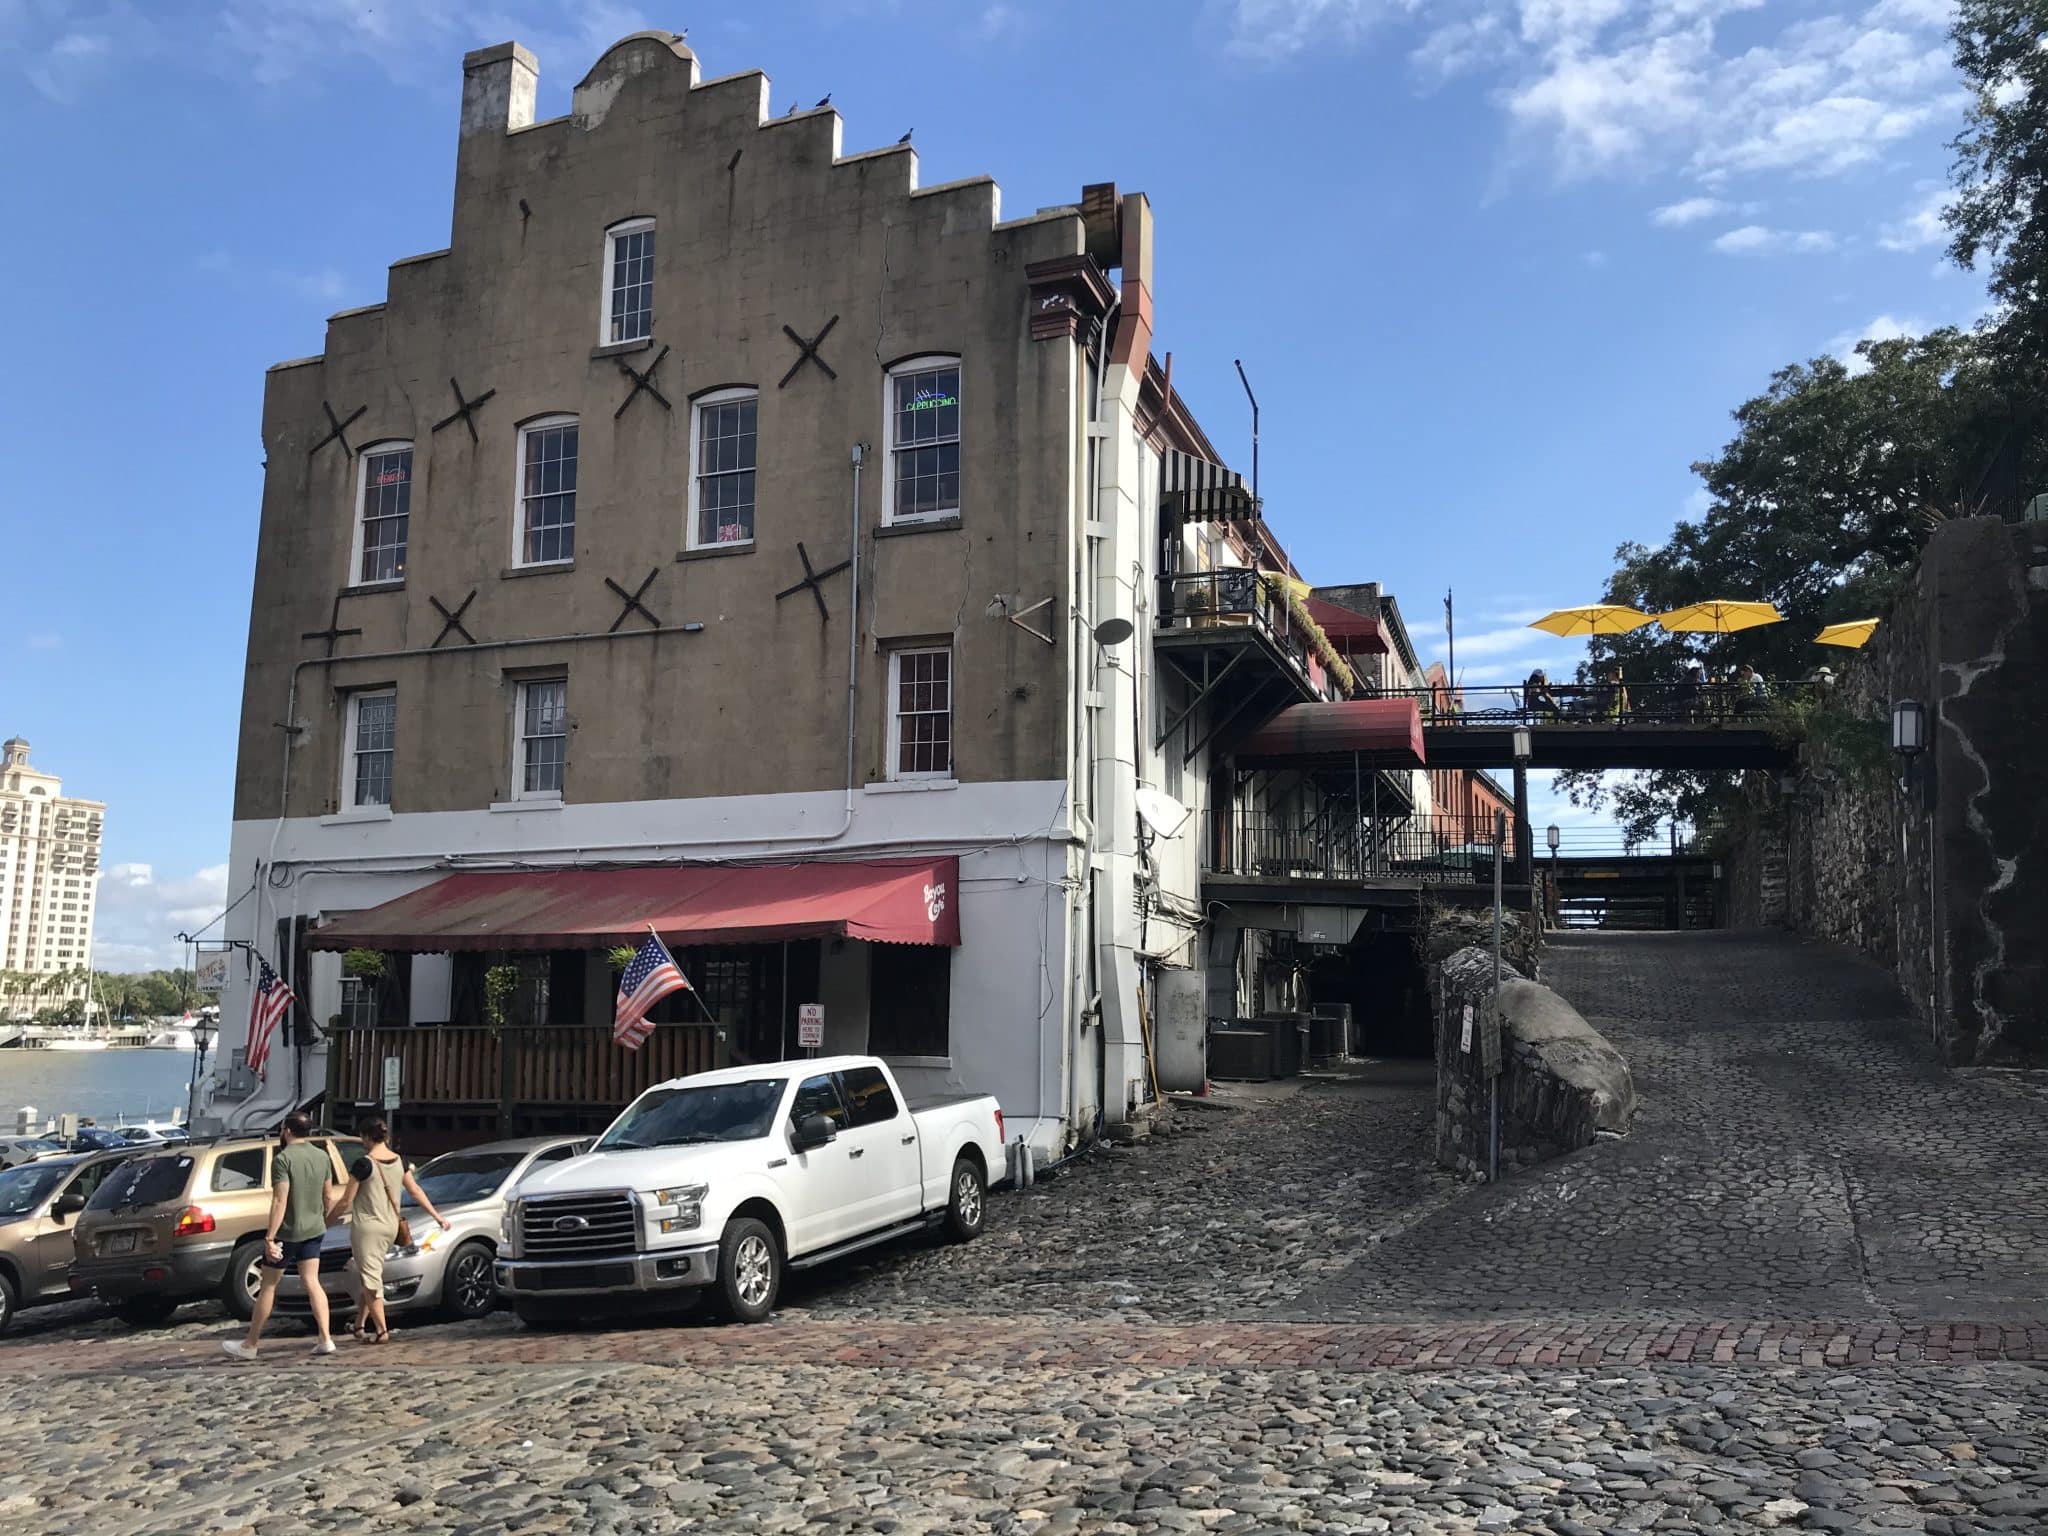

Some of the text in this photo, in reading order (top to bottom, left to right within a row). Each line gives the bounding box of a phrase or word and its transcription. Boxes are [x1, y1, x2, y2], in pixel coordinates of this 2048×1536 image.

[906, 396, 957, 411] CAPPUCCINO
[923, 882, 946, 904] Bayou
[807, 1007, 817, 1017] NO
[800, 1017, 822, 1026] PARKING
